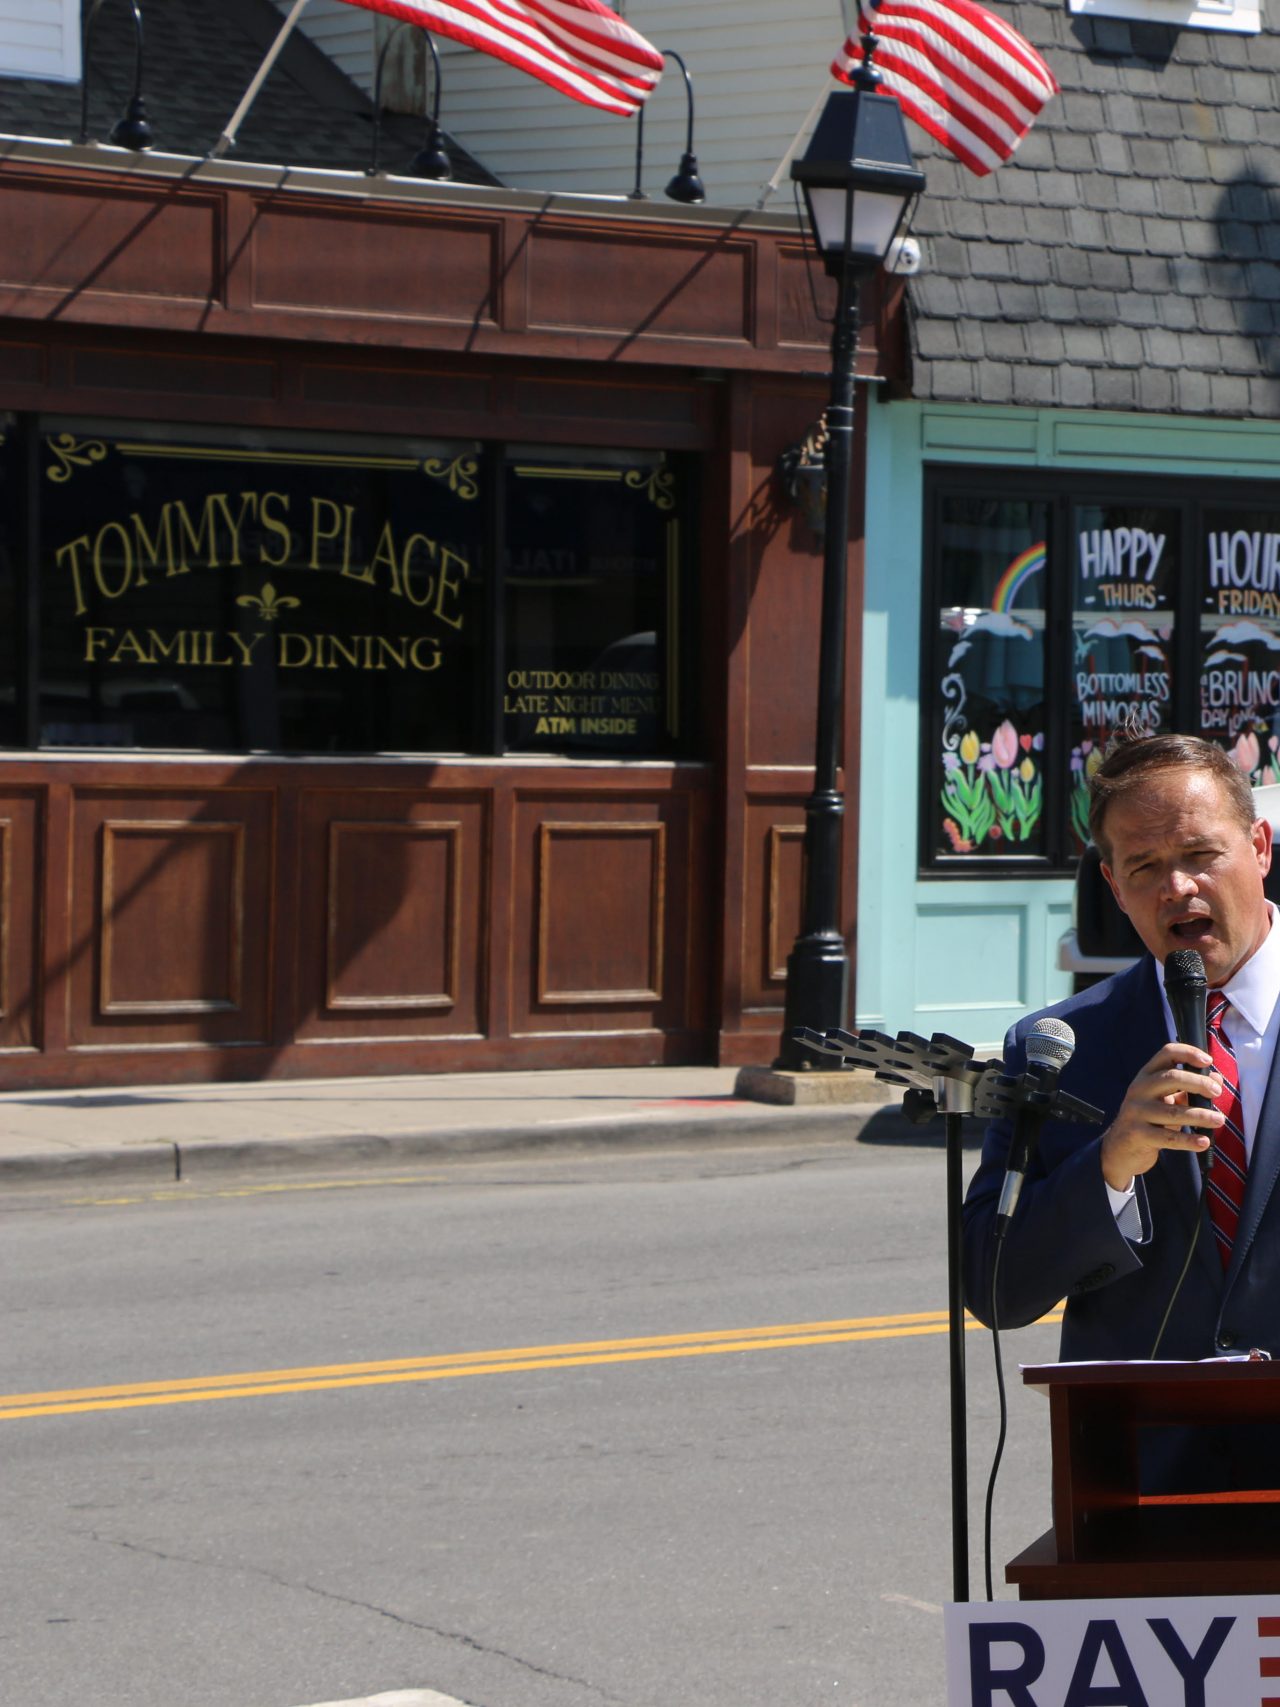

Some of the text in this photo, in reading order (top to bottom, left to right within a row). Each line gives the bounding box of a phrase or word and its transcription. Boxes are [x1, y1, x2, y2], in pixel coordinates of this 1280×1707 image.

[56, 491, 470, 630] TOMMY'S PLACE
[1080, 527, 1166, 582] HAPPY
[83, 627, 443, 672] FAMILY DINING
[507, 670, 659, 690] OUTDOOR DINING
[1076, 671, 1168, 701] BOTTOMLESS
[503, 695, 548, 714] LATE
[554, 695, 606, 714] NIGHT
[1082, 700, 1161, 727] MIMOSAS
[1201, 708, 1229, 728] DAY
[535, 716, 638, 735] ATM INSIDE
[968, 1616, 1238, 1707] RAY
